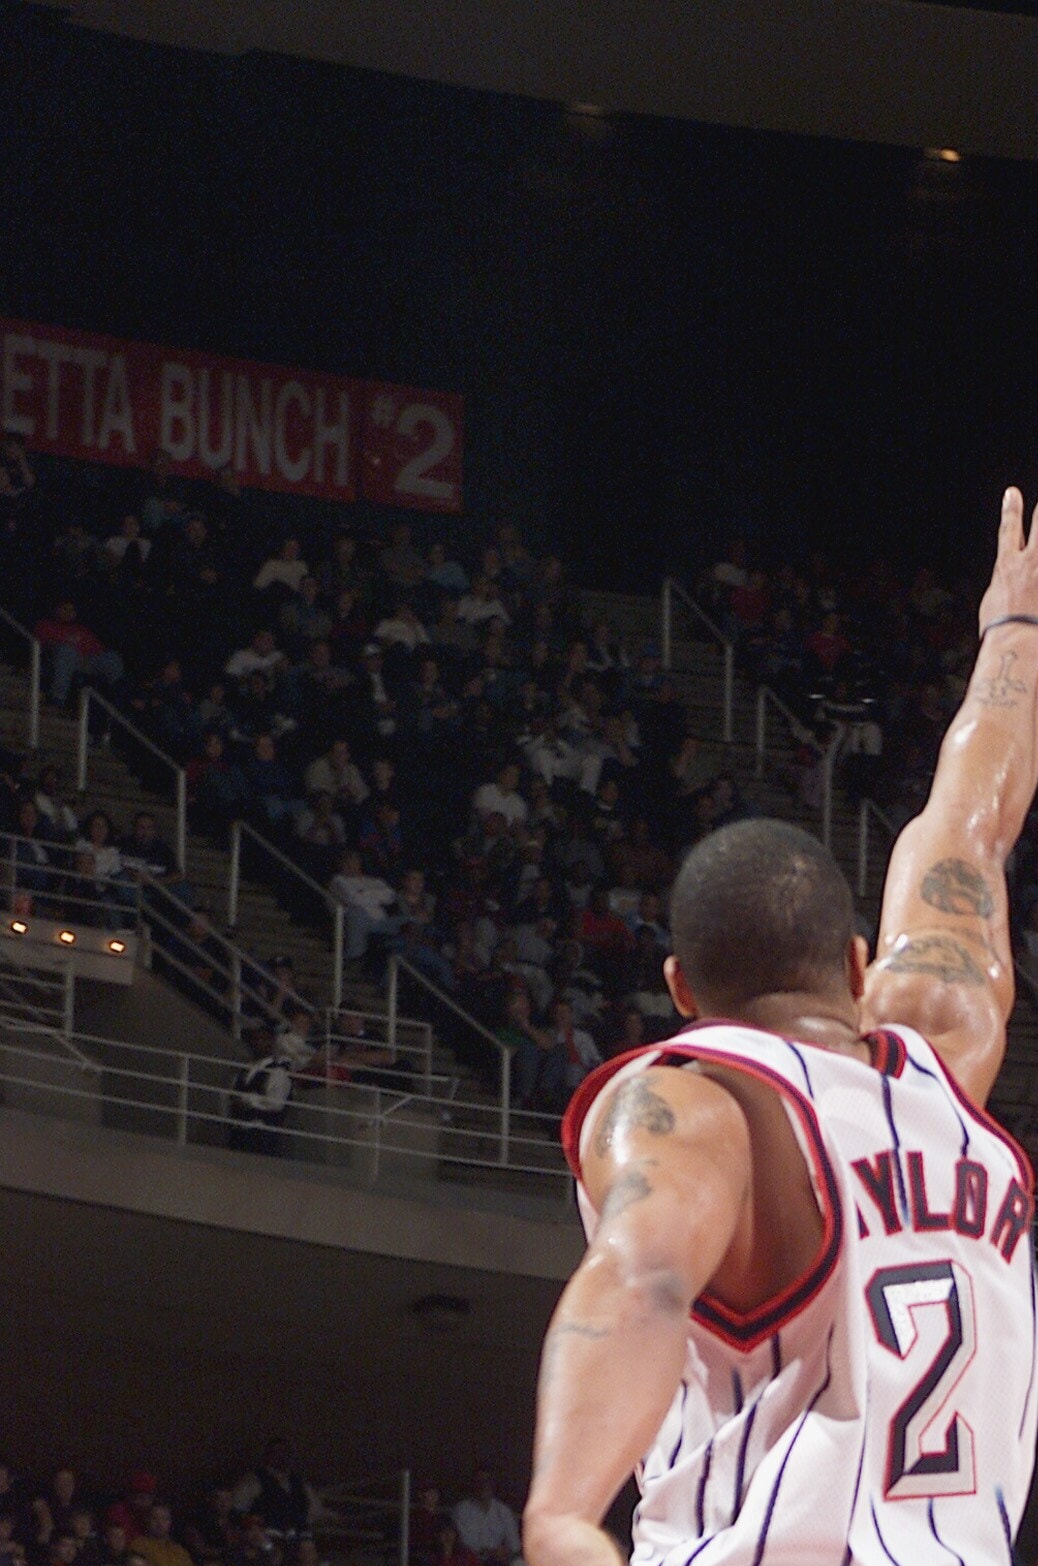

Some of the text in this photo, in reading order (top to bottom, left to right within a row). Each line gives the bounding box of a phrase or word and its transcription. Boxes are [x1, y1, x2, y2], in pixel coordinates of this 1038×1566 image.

[160, 361, 351, 486] BUNCH
[851, 1150, 1031, 1265] YLOR
[865, 1259, 977, 1502] 2
